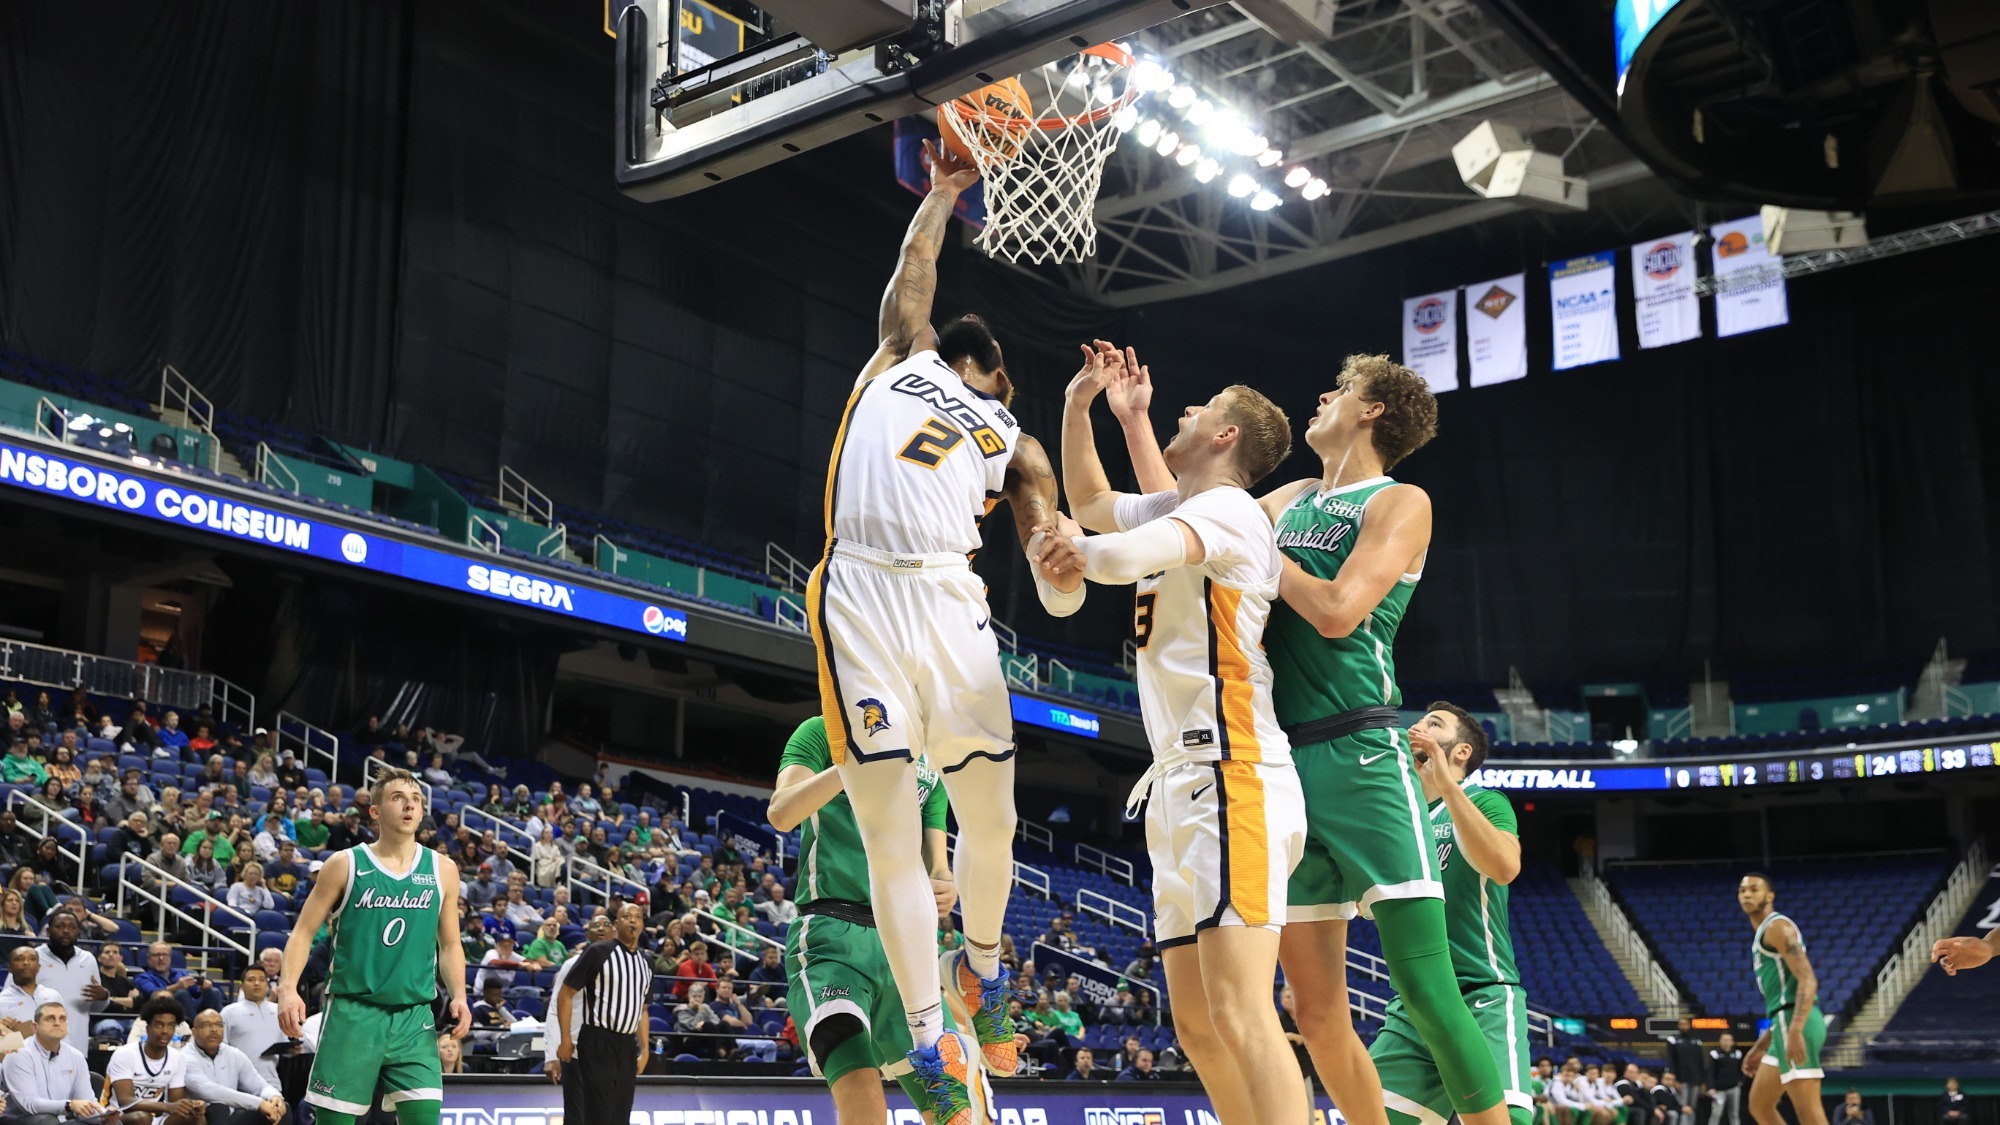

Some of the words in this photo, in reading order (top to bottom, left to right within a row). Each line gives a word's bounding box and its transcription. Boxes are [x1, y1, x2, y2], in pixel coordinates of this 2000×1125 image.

[890, 373, 1008, 460] UNCG
[895, 416, 966, 471] 2
[0, 448, 146, 509] NSBORO
[155, 488, 311, 550] COLISEUM
[1323, 498, 1362, 518] SBC
[893, 557, 923, 568] UNCG
[466, 564, 573, 612] SEGRA
[1872, 755, 1897, 776] 24
[1941, 749, 1966, 769] 33
[1677, 769, 1690, 788] 0
[1743, 767, 1757, 785] 2
[1811, 762, 1824, 780] 3
[411, 872, 435, 886] SBC
[354, 887, 434, 909] Marshall
[382, 917, 406, 947] 0
[820, 984, 850, 1001] Herd
[312, 1078, 336, 1094] Herd
